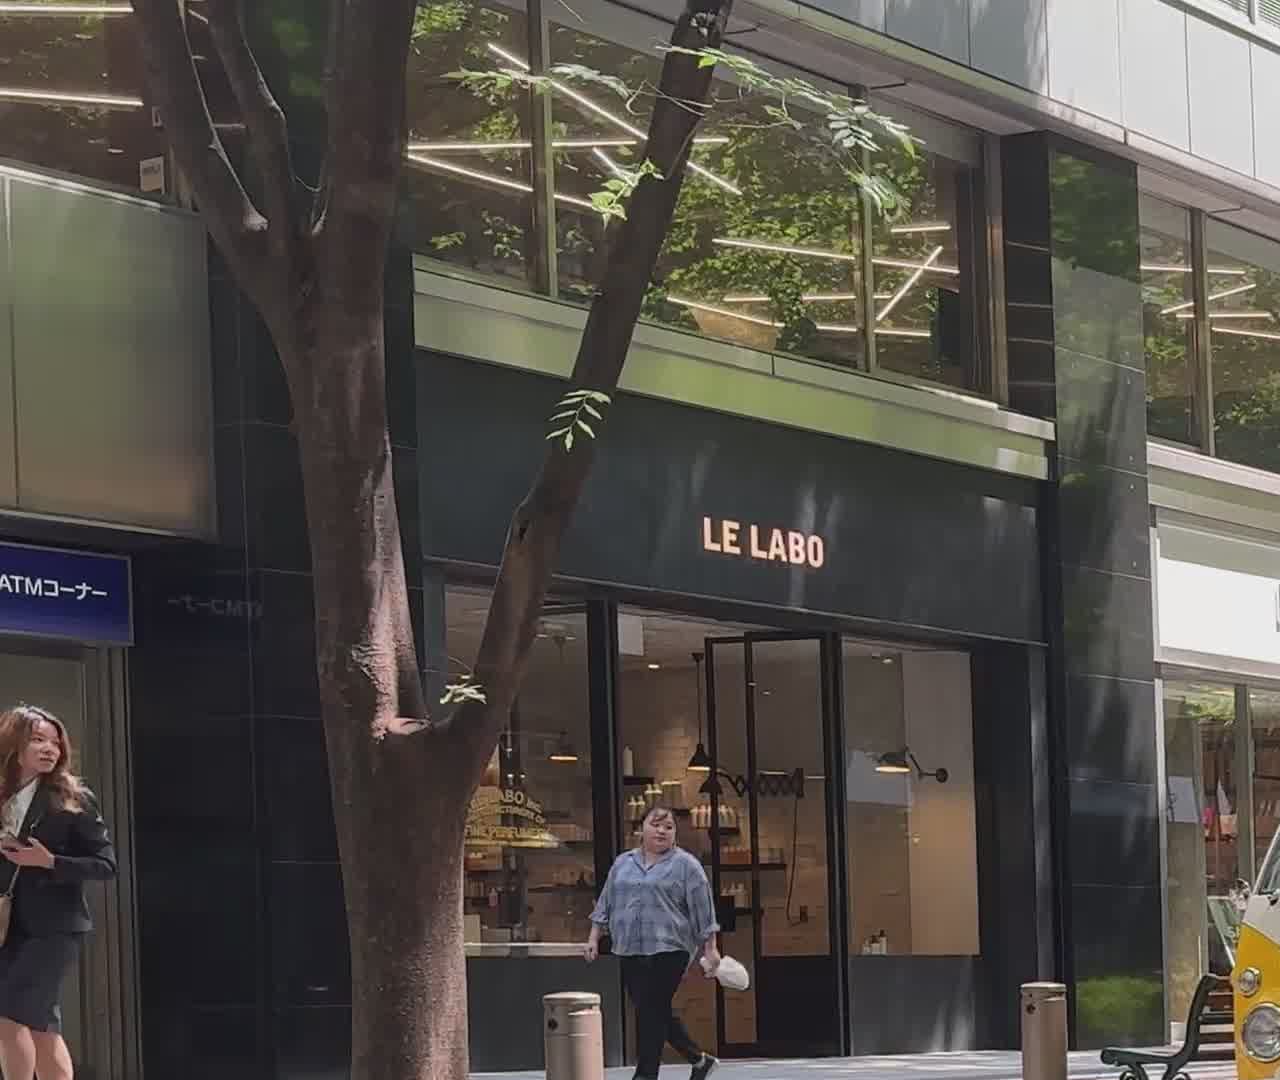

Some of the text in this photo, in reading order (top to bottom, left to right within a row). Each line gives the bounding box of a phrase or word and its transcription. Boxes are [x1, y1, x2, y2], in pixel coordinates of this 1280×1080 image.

[703, 517, 824, 568] LE LABO
[0, 574, 108, 600] ATMコーナー
